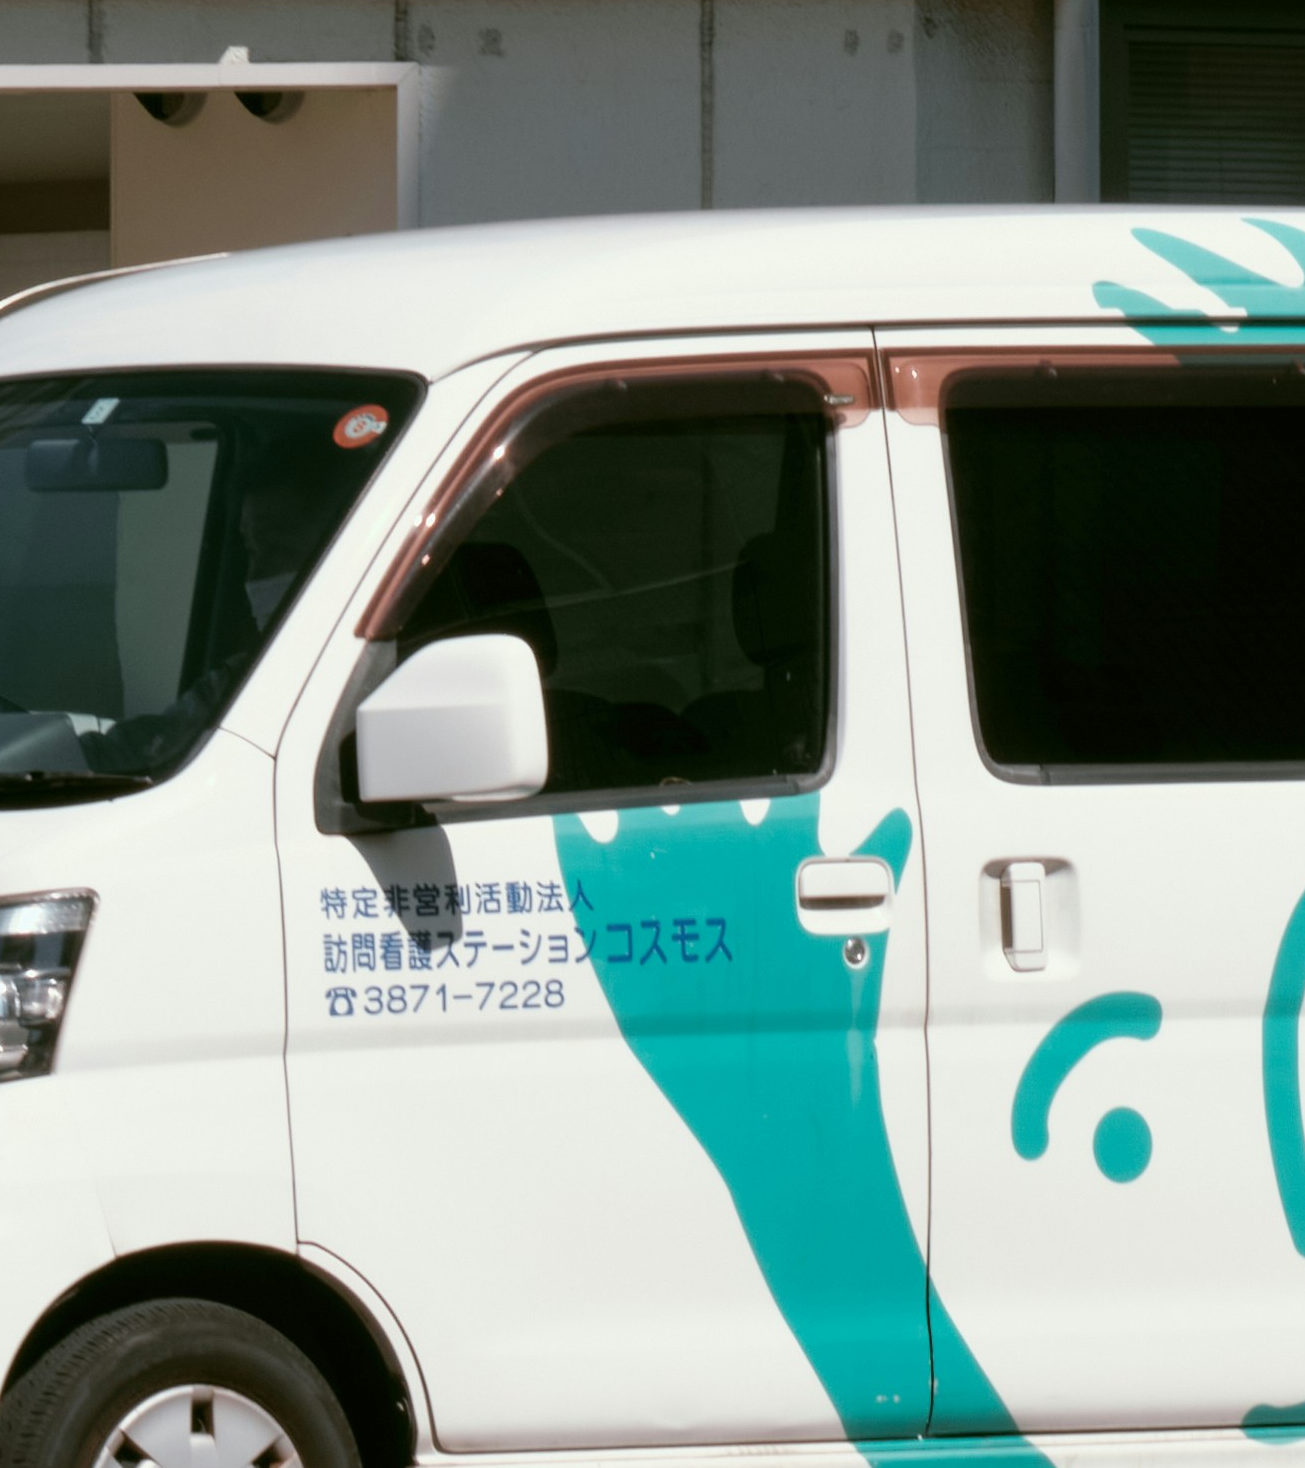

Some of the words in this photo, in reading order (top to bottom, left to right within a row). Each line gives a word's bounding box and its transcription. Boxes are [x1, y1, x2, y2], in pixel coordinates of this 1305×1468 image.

[320, 878, 595, 919] 特定非営利活動法人
[362, 979, 566, 1015] 3871-7228
